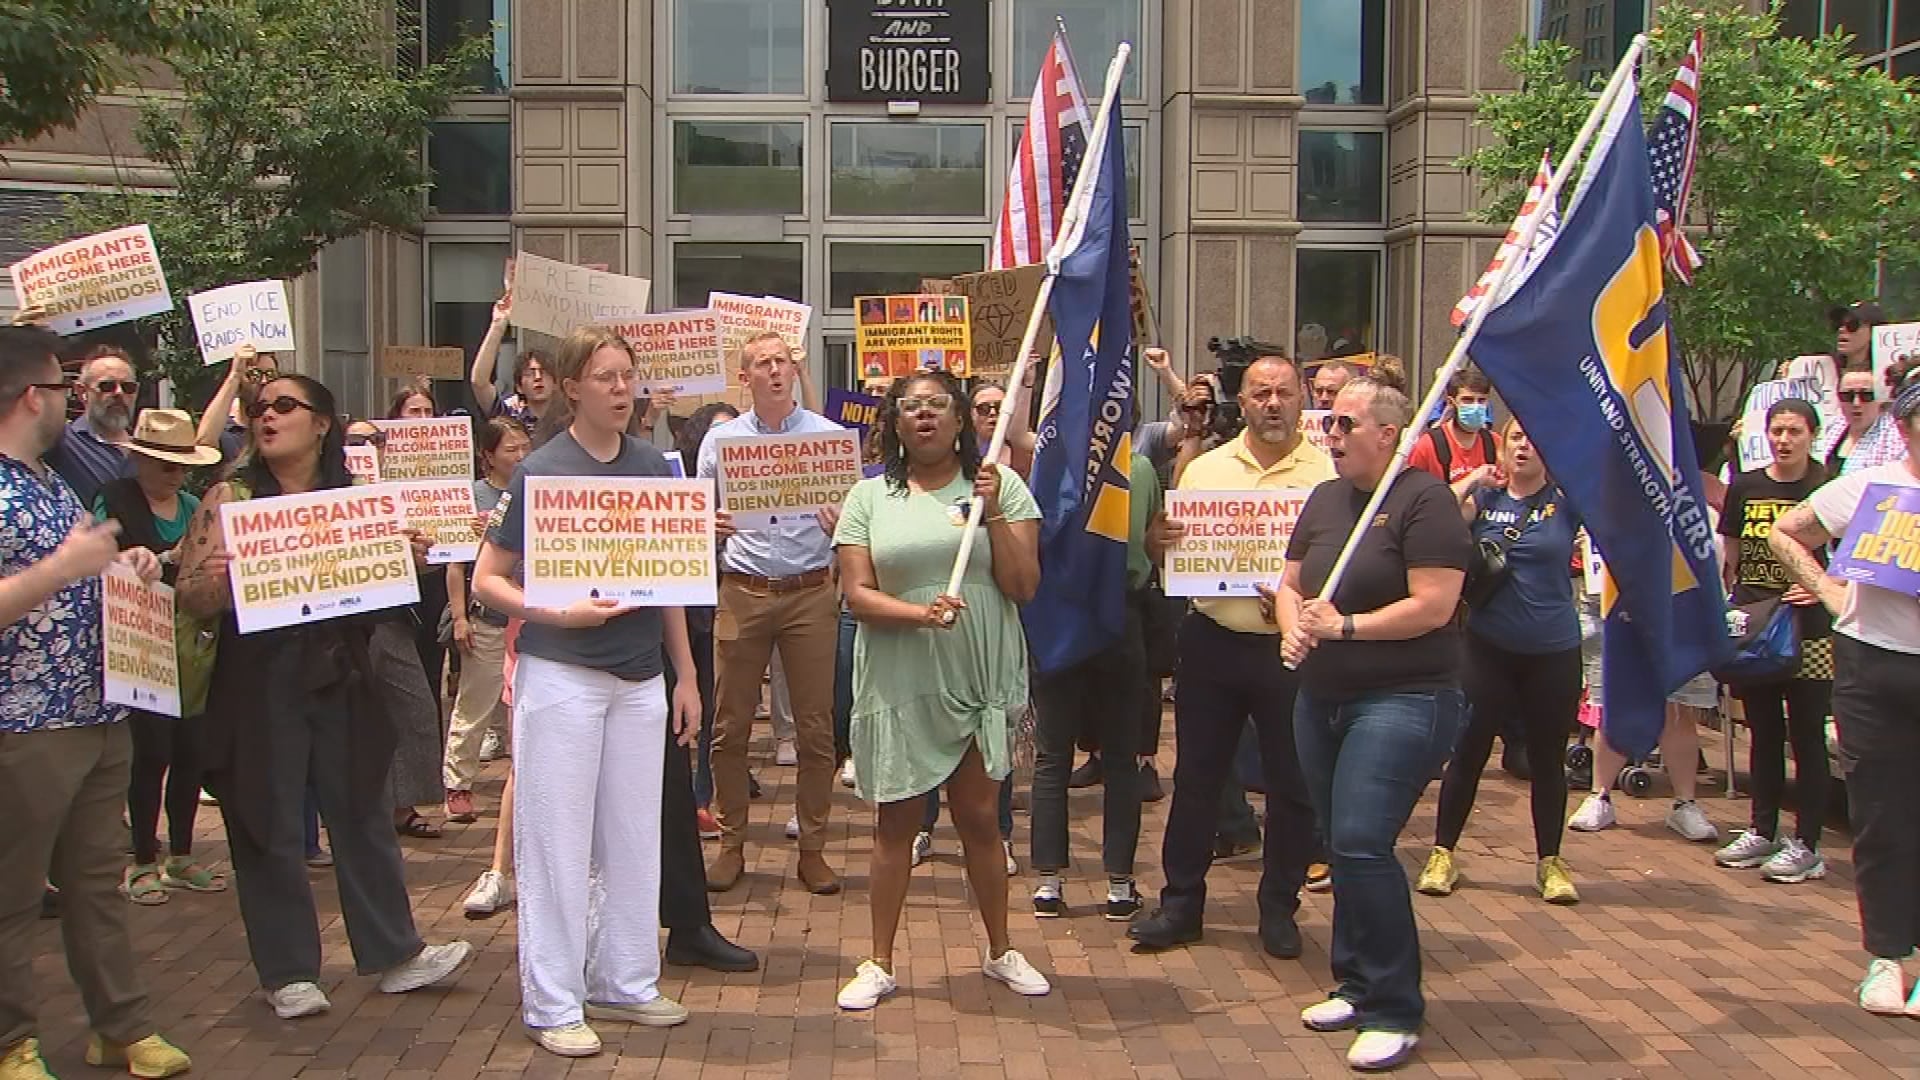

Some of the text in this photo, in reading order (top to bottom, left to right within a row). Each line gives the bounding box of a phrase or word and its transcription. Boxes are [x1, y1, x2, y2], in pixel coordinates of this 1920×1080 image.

[884, 20, 932, 36] AND
[861, 48, 960, 92] BURGER
[19, 234, 147, 283] IMMIGRANTS
[22, 252, 153, 294] WELCOME HERE
[58, 265, 156, 297] INMIGRANTES
[523, 255, 609, 296] FREE
[45, 279, 162, 316] ENVENIDOS!
[202, 292, 280, 324] END ICE
[517, 285, 571, 313] DAVID
[713, 299, 803, 322] IMMIGRANTS
[201, 320, 287, 353] RAIDS NOW
[607, 318, 716, 339] MIGRANTS
[770, 321, 800, 335] HERE
[864, 325, 963, 337] IMMIGRANT RIGHTS
[633, 339, 676, 353] COME
[679, 336, 717, 349] HERE
[865, 337, 964, 347] ARE WORKER RIGHTS
[638, 350, 719, 364] MIGRANTES
[640, 361, 721, 380] VENIDOS!
[841, 401, 864, 423] NO
[386, 423, 468, 441] MIGRANTS
[1579, 355, 1608, 399] UNITY
[1599, 396, 1625, 431] AND
[1619, 431, 1672, 518] STRENGTH
[386, 439, 469, 454] ELCOME HERE
[722, 439, 854, 463] IMMIGRANTS
[380, 463, 470, 479] IENVENIDOS!
[724, 459, 856, 479] WELCOME HERE
[761, 474, 857, 490] INMIGRANTES
[400, 487, 471, 503] IGRANTS
[534, 489, 706, 511] IMMIGRANTS
[728, 489, 849, 511] BIENVENIDO
[232, 495, 395, 537] IMMIGRANTS
[406, 504, 473, 517] COME HERE
[1172, 500, 1304, 518] IMMIGRANT
[1672, 467, 1714, 560] KERS
[1744, 503, 1788, 520] NEV
[407, 517, 470, 529] INMIGRANTE
[535, 517, 706, 534] WELCOME HERE
[1271, 521, 1294, 537] HE
[1879, 510, 1920, 542] DIG
[237, 520, 399, 559] WELCOME HERE
[535, 537, 708, 552] ¡LOS INMIGRANTES
[1212, 539, 1287, 552] INMIGRAN
[1741, 539, 1773, 561] PA
[287, 540, 404, 570] INMIGRANTES
[1851, 532, 1920, 573] DEPO
[535, 559, 709, 577] BIENVENIDOS!
[1173, 557, 1284, 574] BIENVENID
[244, 559, 408, 603] BIENVENIDOS!
[107, 575, 172, 621] IMMIGRANTS
[108, 602, 153, 634] WELCOME
